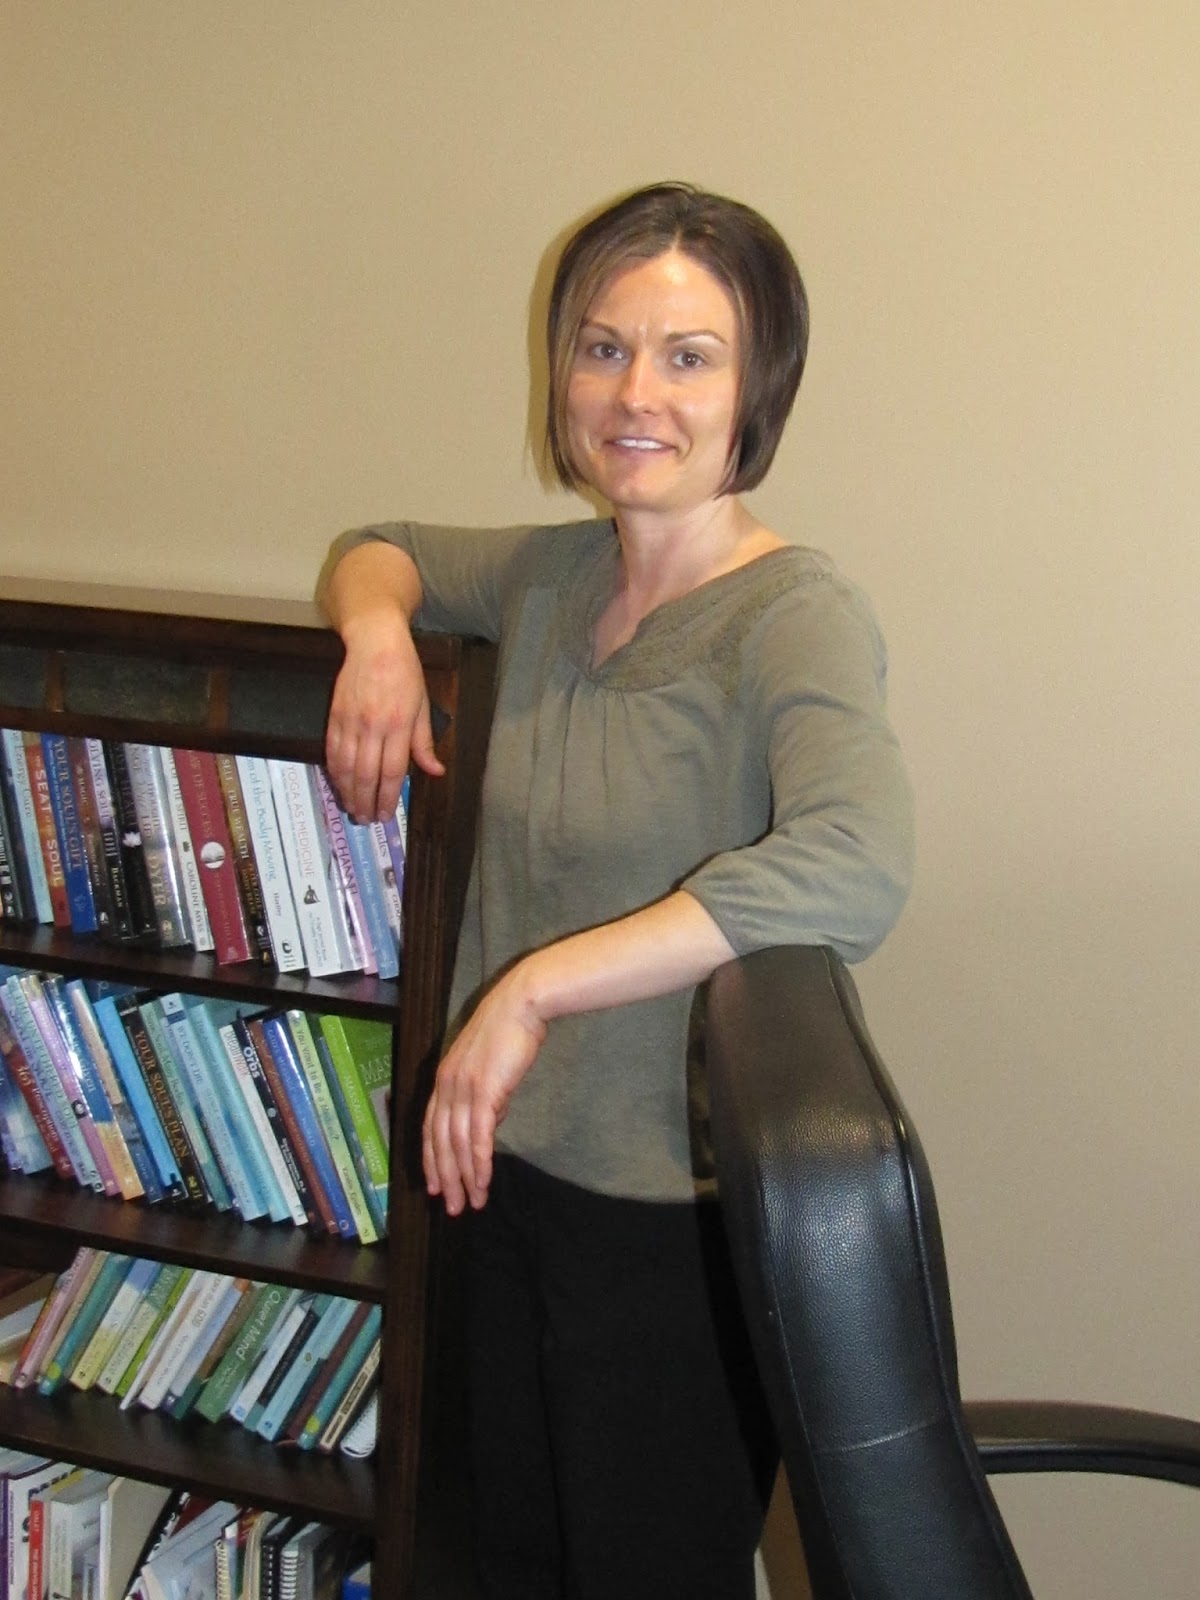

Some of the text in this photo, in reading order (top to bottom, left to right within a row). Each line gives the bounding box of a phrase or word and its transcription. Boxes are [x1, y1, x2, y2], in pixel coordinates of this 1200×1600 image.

[52, 738, 70, 781] YOUR
[250, 786, 264, 806] the
[285, 764, 302, 799] YOGA
[34, 768, 52, 814] SEAT
[45, 838, 64, 886] SOUL
[60, 785, 78, 834] SOUL'S
[87, 739, 124, 908] OLVING SOUL BACKMAN
[195, 791, 214, 838] SUCCESS
[253, 807, 273, 839] Body
[292, 801, 304, 818] AS
[329, 815, 343, 834] TO
[68, 836, 83, 870] GIFT
[233, 816, 250, 859] WEALTH
[295, 820, 315, 878] MEDICINE
[146, 854, 167, 907] DYER
[176, 802, 188, 831] SPIRIT
[185, 861, 201, 907] CAROLINE
[193, 908, 205, 933] MYSS
[261, 839, 279, 882] Moving
[334, 841, 358, 895] CHANNEL
[14, 1064, 34, 1087] 365
[242, 1045, 262, 1078] Orbs
[132, 1029, 158, 1070] YOUR
[149, 1071, 176, 1120] SOUL'S
[166, 1120, 190, 1159] PLAN
[233, 1289, 282, 1361] Quiet Mind
